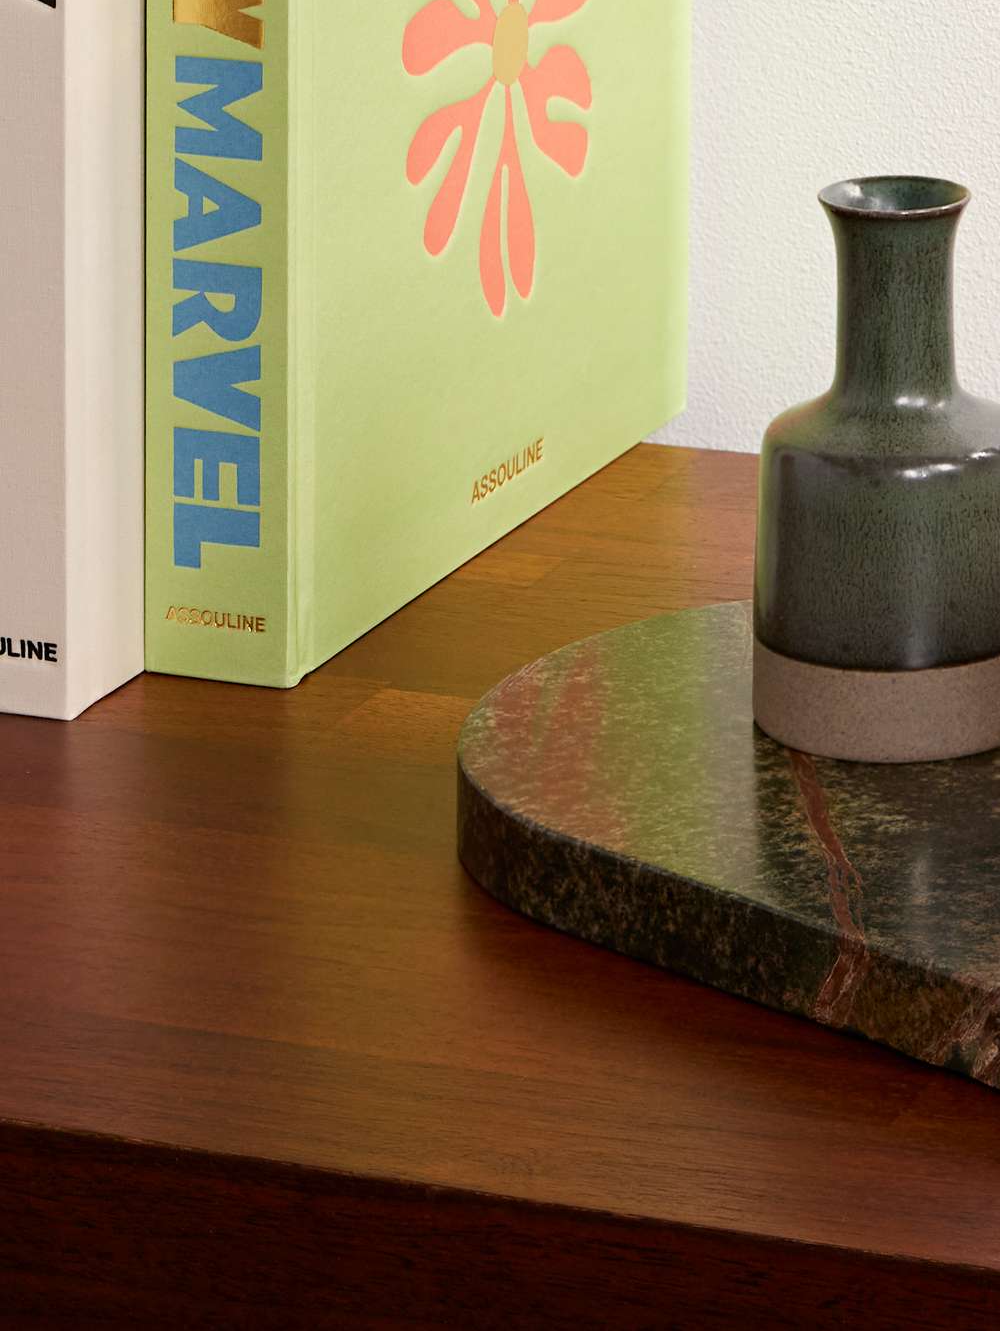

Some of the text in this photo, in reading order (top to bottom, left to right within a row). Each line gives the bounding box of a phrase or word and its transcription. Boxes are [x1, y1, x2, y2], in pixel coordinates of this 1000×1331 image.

[172, 54, 263, 568] MARVEL
[470, 437, 544, 504] ASSOULINE
[165, 605, 266, 633] ASSOULINE
